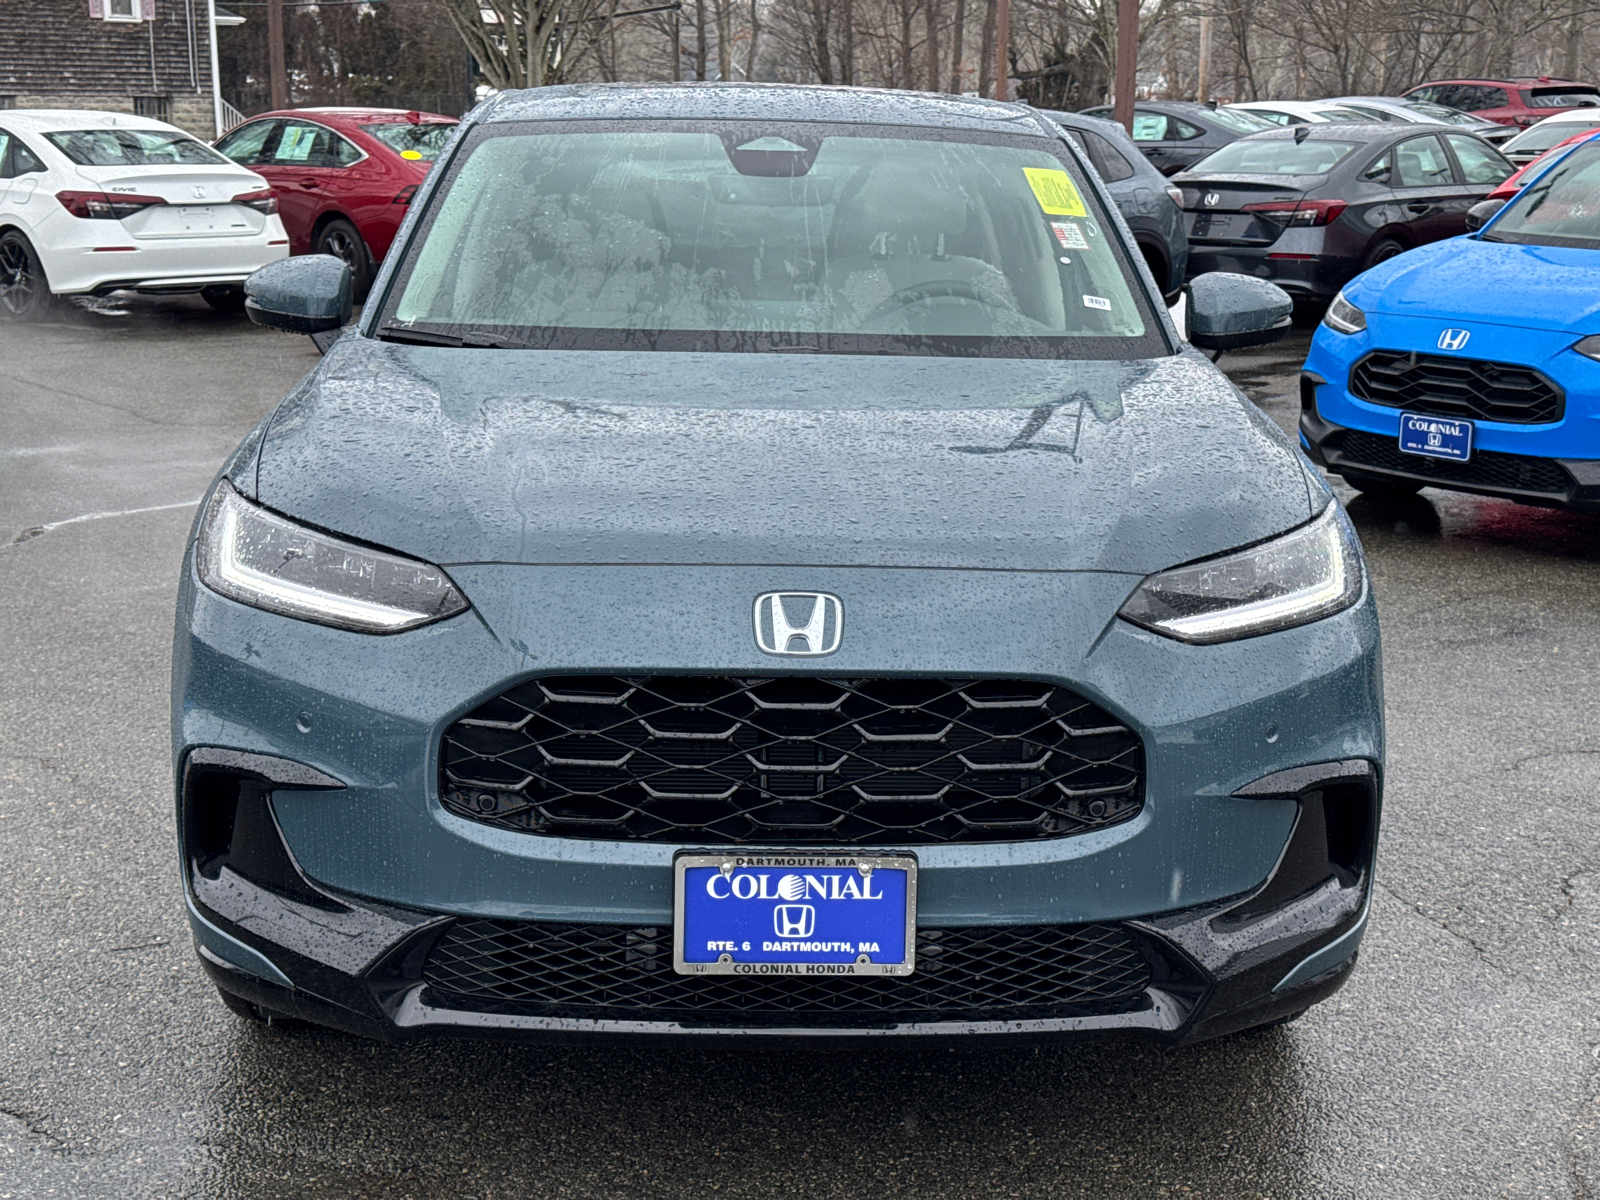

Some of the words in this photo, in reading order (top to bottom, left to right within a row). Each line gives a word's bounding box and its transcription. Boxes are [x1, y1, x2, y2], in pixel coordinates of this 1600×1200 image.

[1408, 420, 1463, 436] COLONIAL
[735, 857, 830, 867] DARTMOUTH,
[706, 874, 883, 900] COLONIAL
[707, 941, 739, 951] RTE.
[742, 941, 751, 951] 6
[762, 941, 855, 954] DARTMOUTH,
[858, 942, 880, 952] MA
[733, 964, 802, 974] COLONIAL
[806, 964, 855, 974] HONDA
